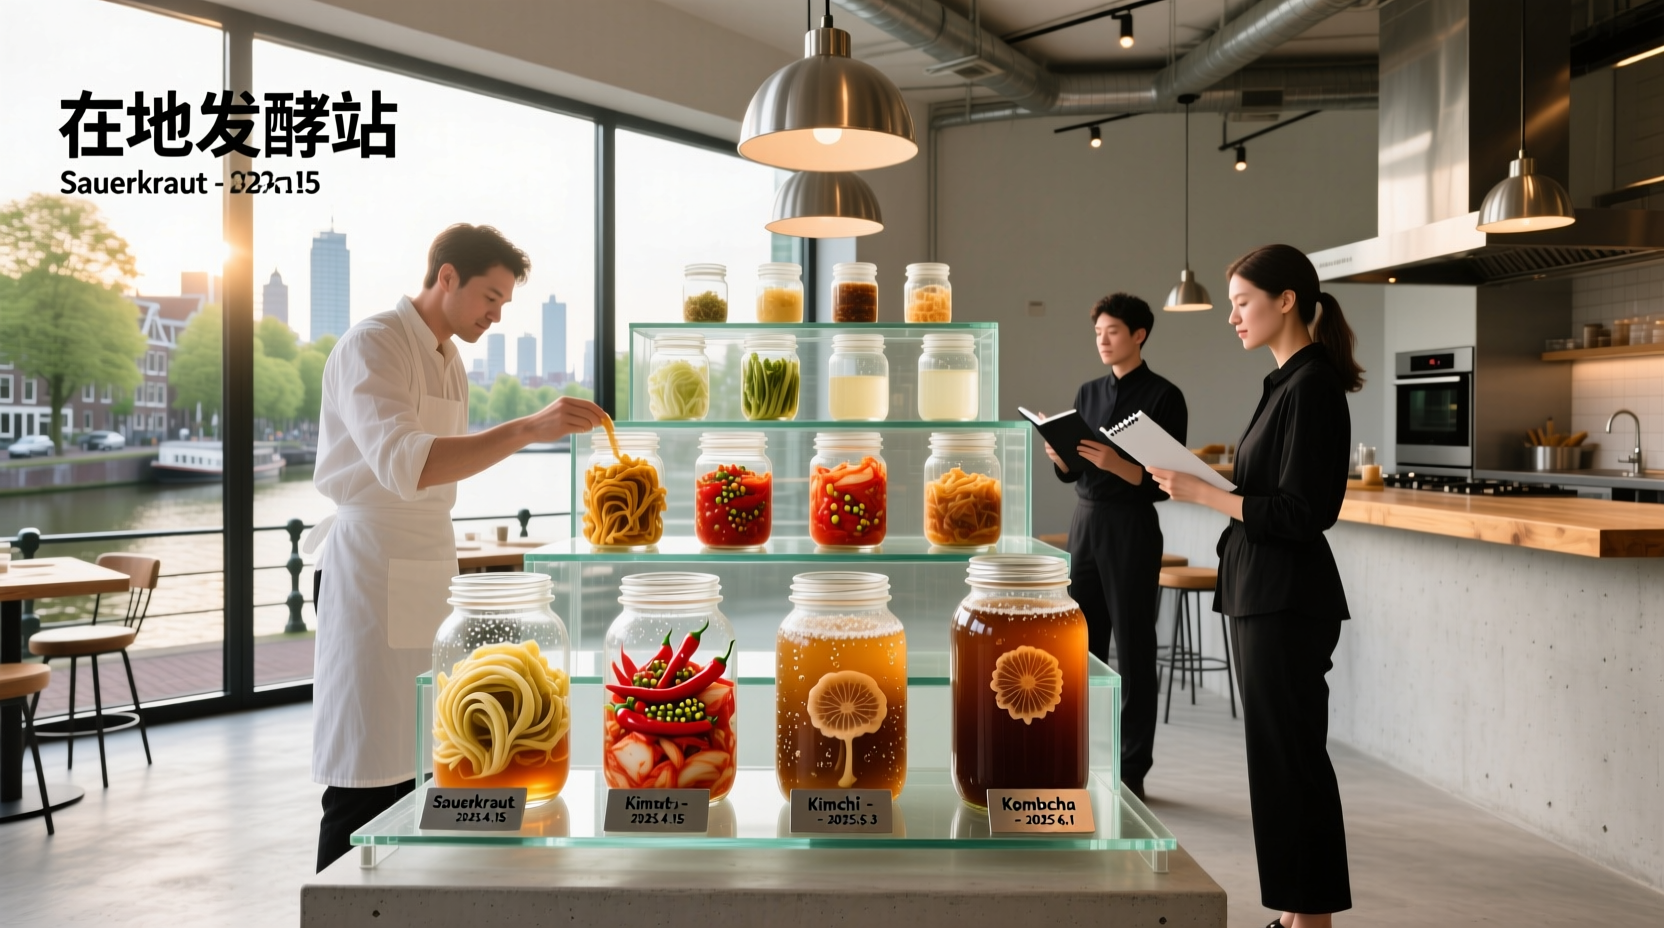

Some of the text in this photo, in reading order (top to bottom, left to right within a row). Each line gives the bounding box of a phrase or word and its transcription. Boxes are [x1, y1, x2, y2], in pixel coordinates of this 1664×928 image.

[432, 793, 516, 809] Sauerkraut
[807, 795, 861, 811] Kimchi
[1001, 796, 1076, 811] Kombcha
